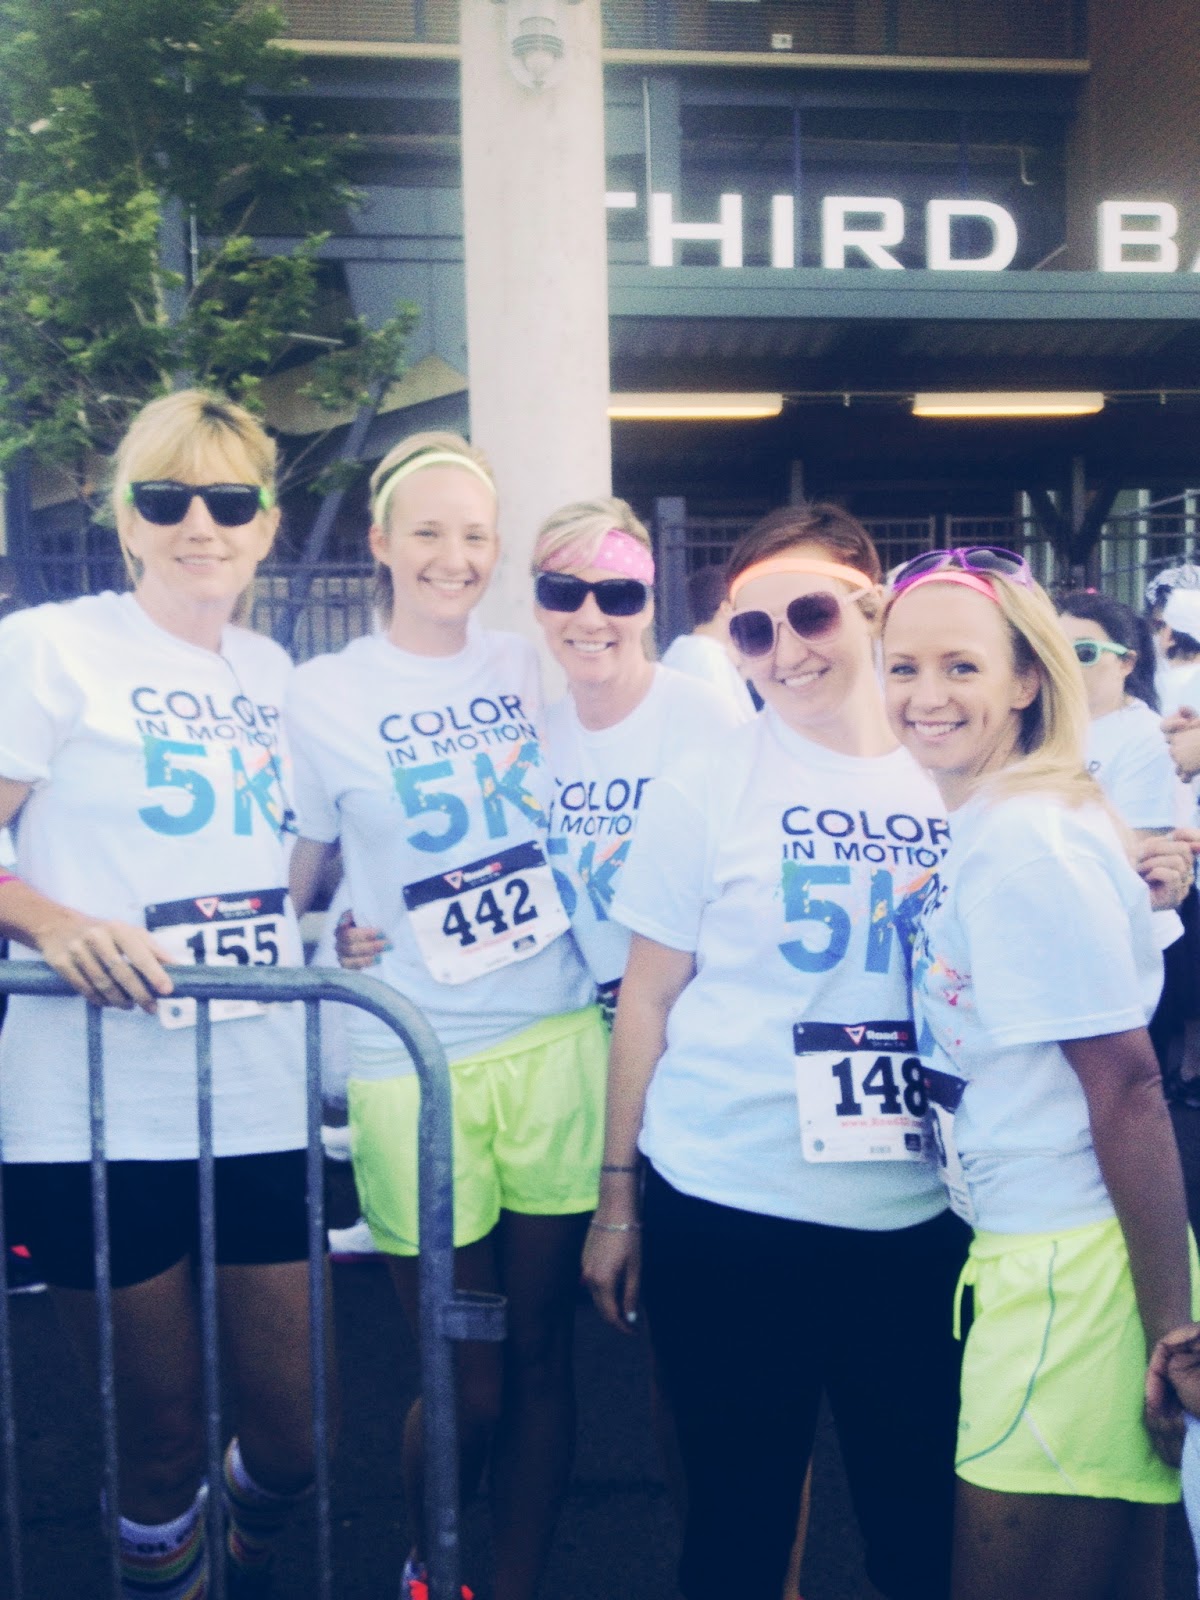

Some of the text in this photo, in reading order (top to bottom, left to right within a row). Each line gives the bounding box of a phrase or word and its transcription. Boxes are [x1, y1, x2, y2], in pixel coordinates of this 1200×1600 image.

[1100, 201, 1200, 273] B
[131, 686, 280, 728] COLOR
[379, 695, 530, 744] COLOR
[136, 719, 279, 748] IN MOTIO
[386, 722, 538, 768] IN MOTION
[137, 734, 286, 847] 5K
[392, 739, 549, 854] 5K
[554, 777, 656, 812] OLO
[561, 814, 639, 836] MOTIO
[781, 805, 952, 845] COLOR
[782, 840, 948, 868] IN MOTIO
[442, 878, 539, 947] 442
[186, 922, 279, 966] 155
[831, 1056, 930, 1118] 148
